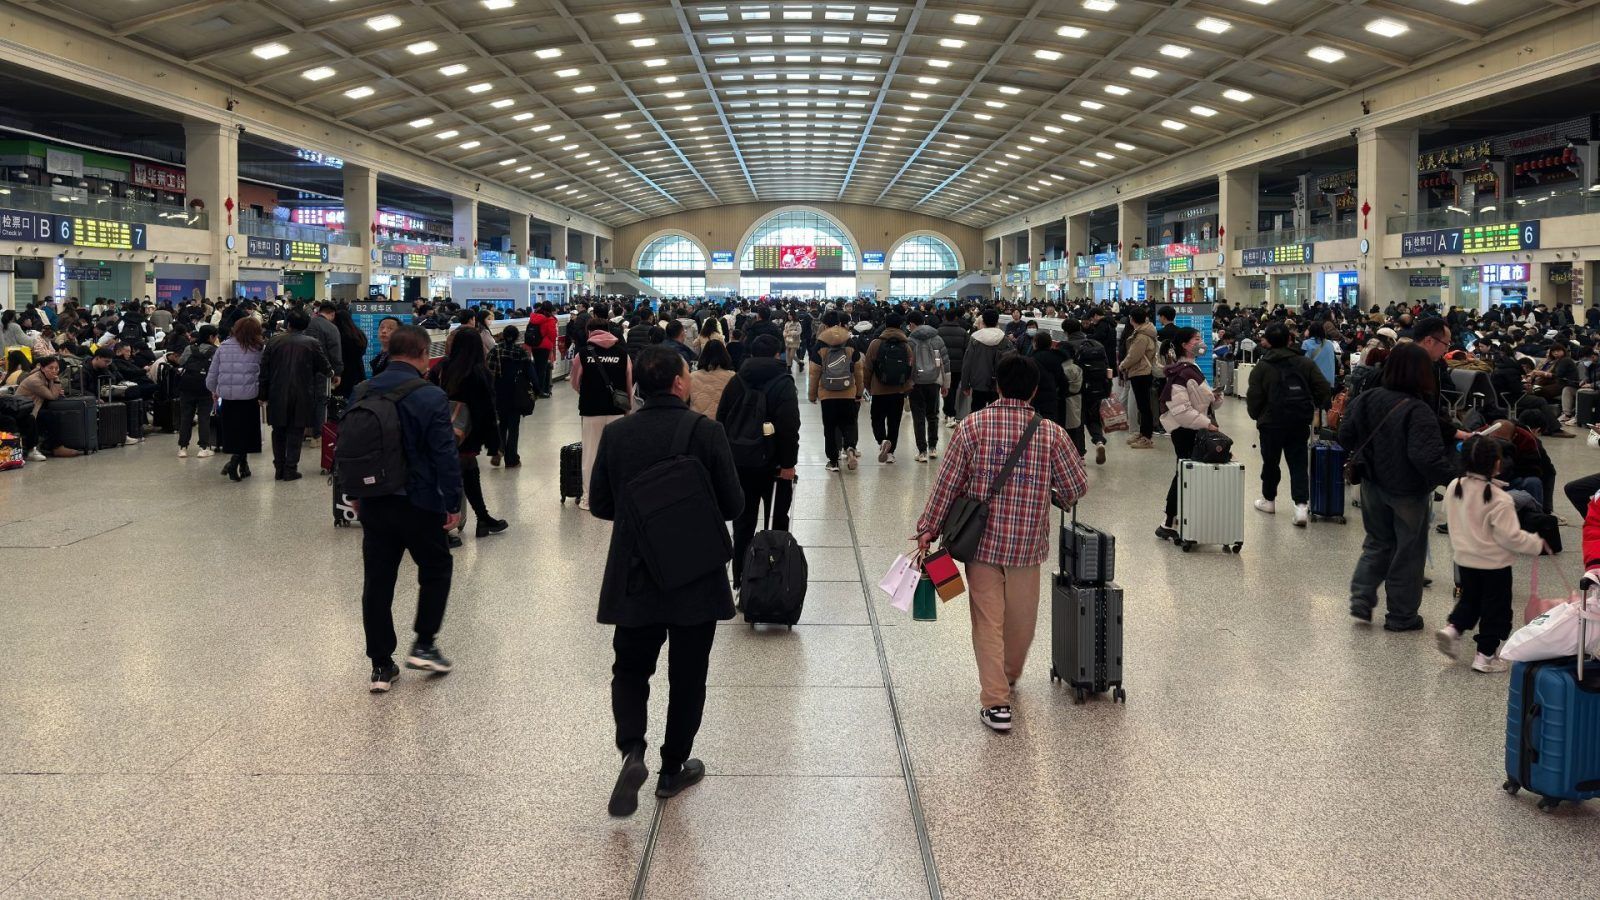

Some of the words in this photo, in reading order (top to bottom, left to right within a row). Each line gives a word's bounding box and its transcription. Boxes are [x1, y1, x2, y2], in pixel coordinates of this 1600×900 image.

[2, 215, 30, 229] 检票口
[40, 218, 50, 238] B
[61, 221, 70, 239] 6
[135, 228, 143, 245] 7
[1414, 236, 1432, 247] 检票口
[1438, 234, 1447, 251] A
[1451, 232, 1459, 250] 7
[1524, 226, 1533, 244] 6
[274, 242, 281, 256] B
[285, 243, 290, 256] 8
[322, 247, 327, 259] 9
[1261, 251, 1267, 263] A
[1268, 250, 1273, 262] 9
[1305, 246, 1310, 259] 8
[356, 304, 367, 312] B2
[370, 304, 392, 313] 候车区
